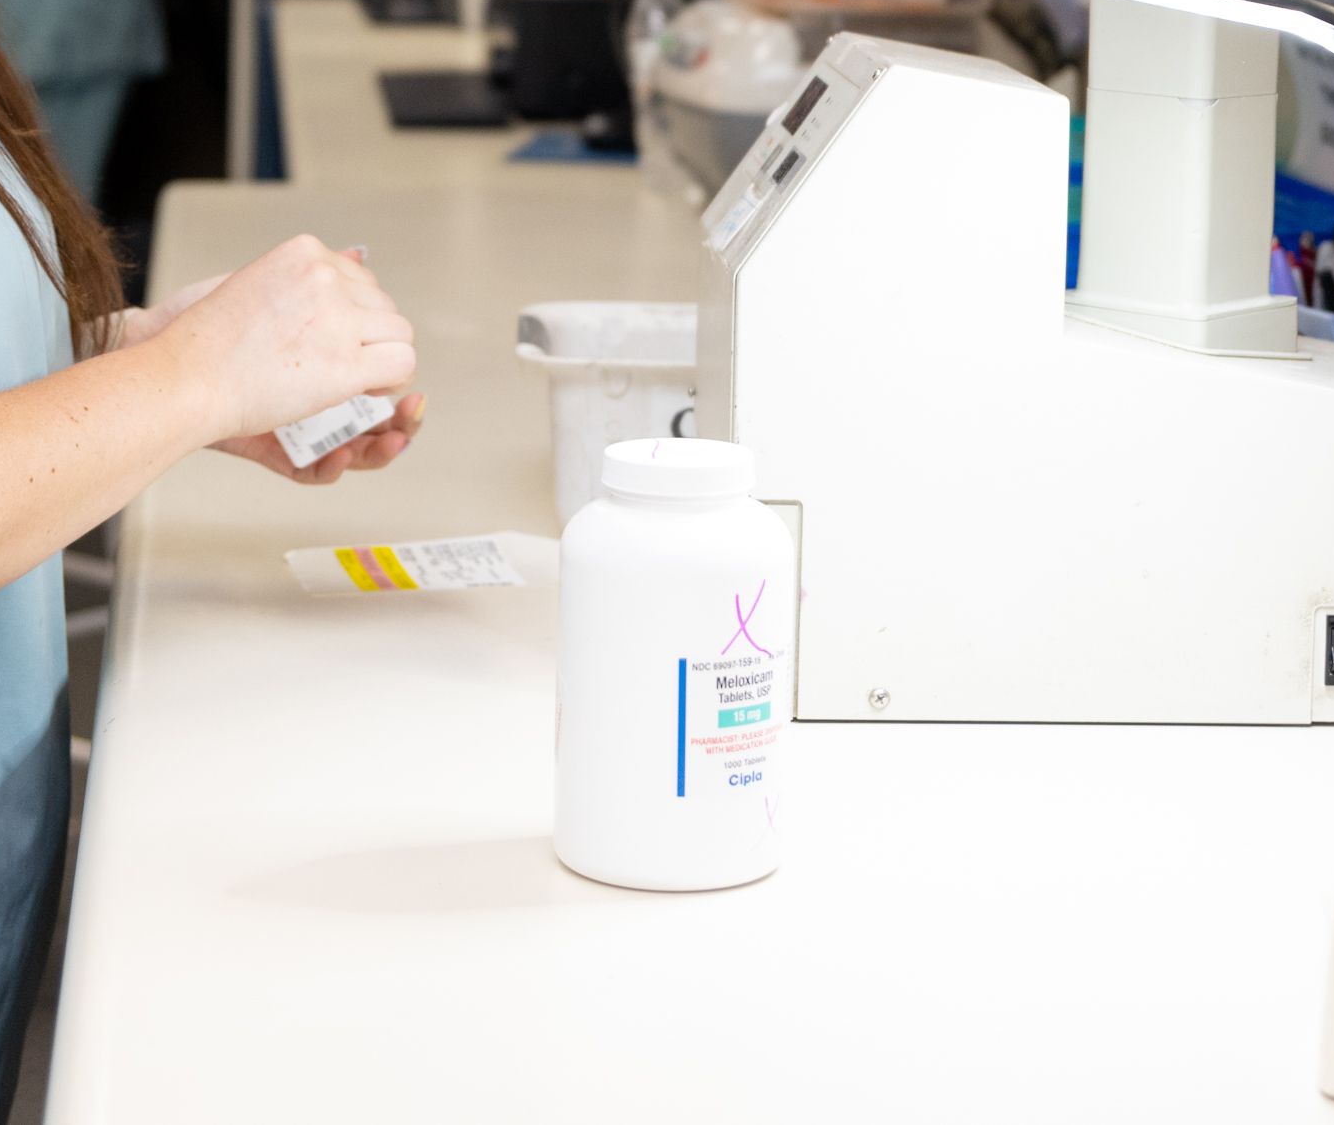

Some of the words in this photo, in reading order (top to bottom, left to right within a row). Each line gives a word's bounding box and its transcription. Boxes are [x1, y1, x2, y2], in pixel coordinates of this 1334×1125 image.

[716, 670, 773, 690] Meloxicam
[734, 710, 745, 723] 15
[728, 770, 763, 787] Cipla
